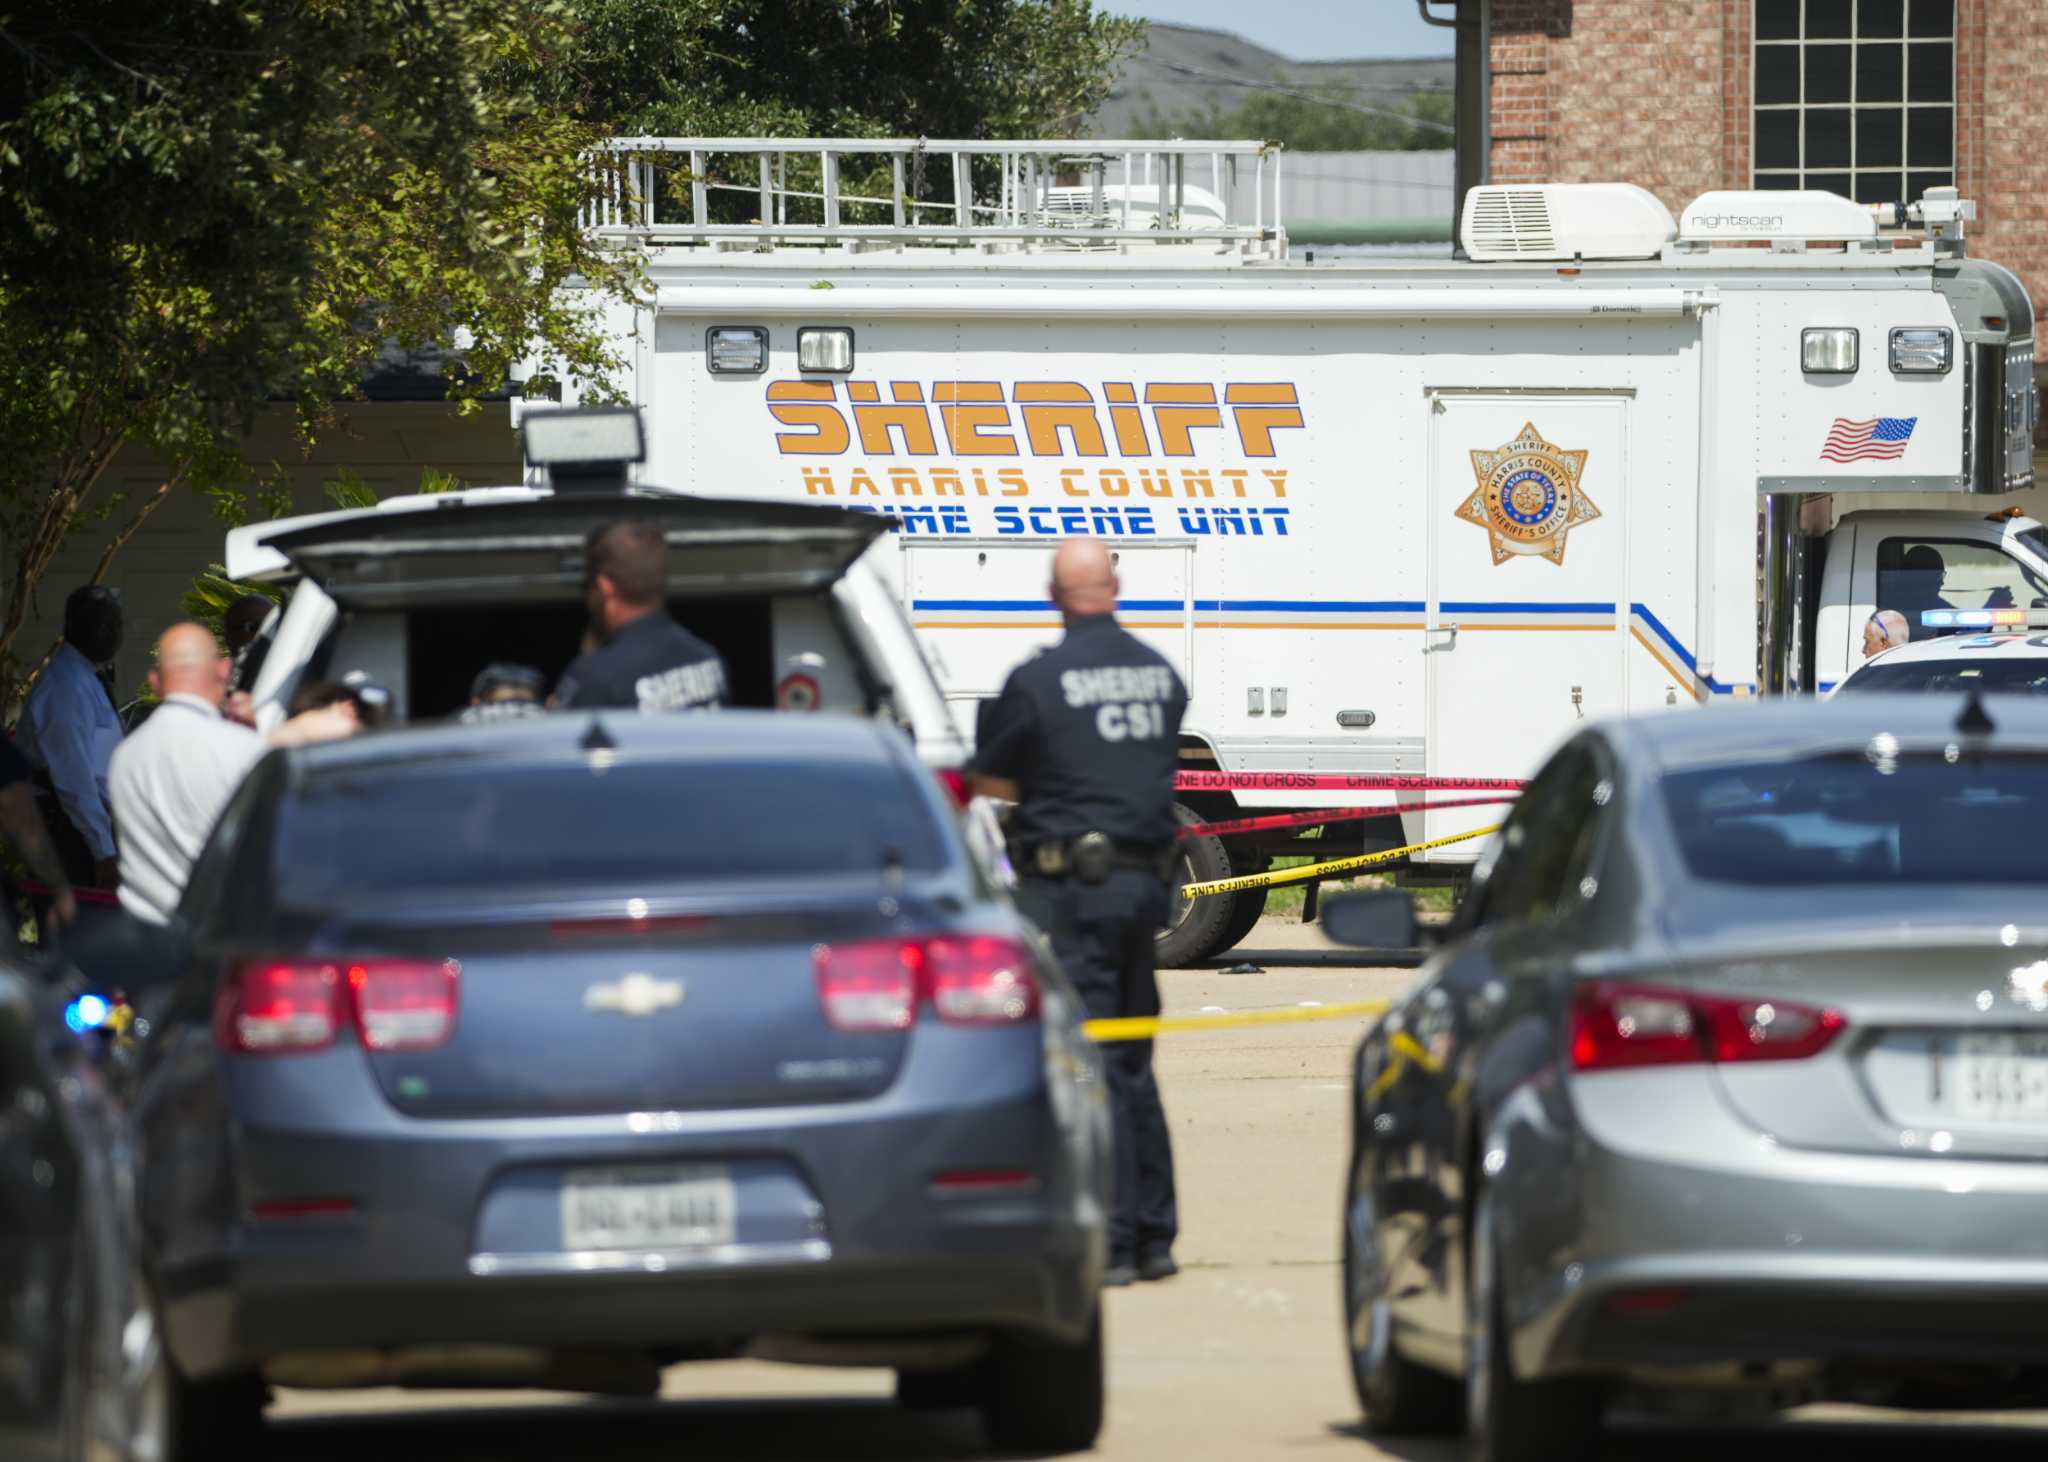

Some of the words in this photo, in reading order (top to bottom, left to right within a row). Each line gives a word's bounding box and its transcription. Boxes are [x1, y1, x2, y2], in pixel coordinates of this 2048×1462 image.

[1692, 213, 1783, 228] nightscan
[766, 380, 1304, 457] SHERIFF
[1507, 441, 1552, 453] SHERIFF
[800, 467, 1029, 496] HARRIS
[1060, 468, 1288, 498] COUNTY
[1491, 458, 1524, 488] HARRIS
[1528, 457, 1566, 487] COUNTY
[993, 506, 1156, 535] SCENE
[1177, 506, 1290, 536] UNIT
[1490, 505, 1536, 537] SHERIFF'S
[1538, 505, 1566, 534] OFFICE
[1060, 665, 1173, 708] SHERIFF
[1096, 702, 1164, 742] CSI
[1203, 774, 1225, 787] DO
[1229, 774, 1258, 787] NOT
[1263, 774, 1317, 787] CROSS
[1346, 776, 1394, 788] CRIME
[1398, 776, 1449, 788] SCENE
